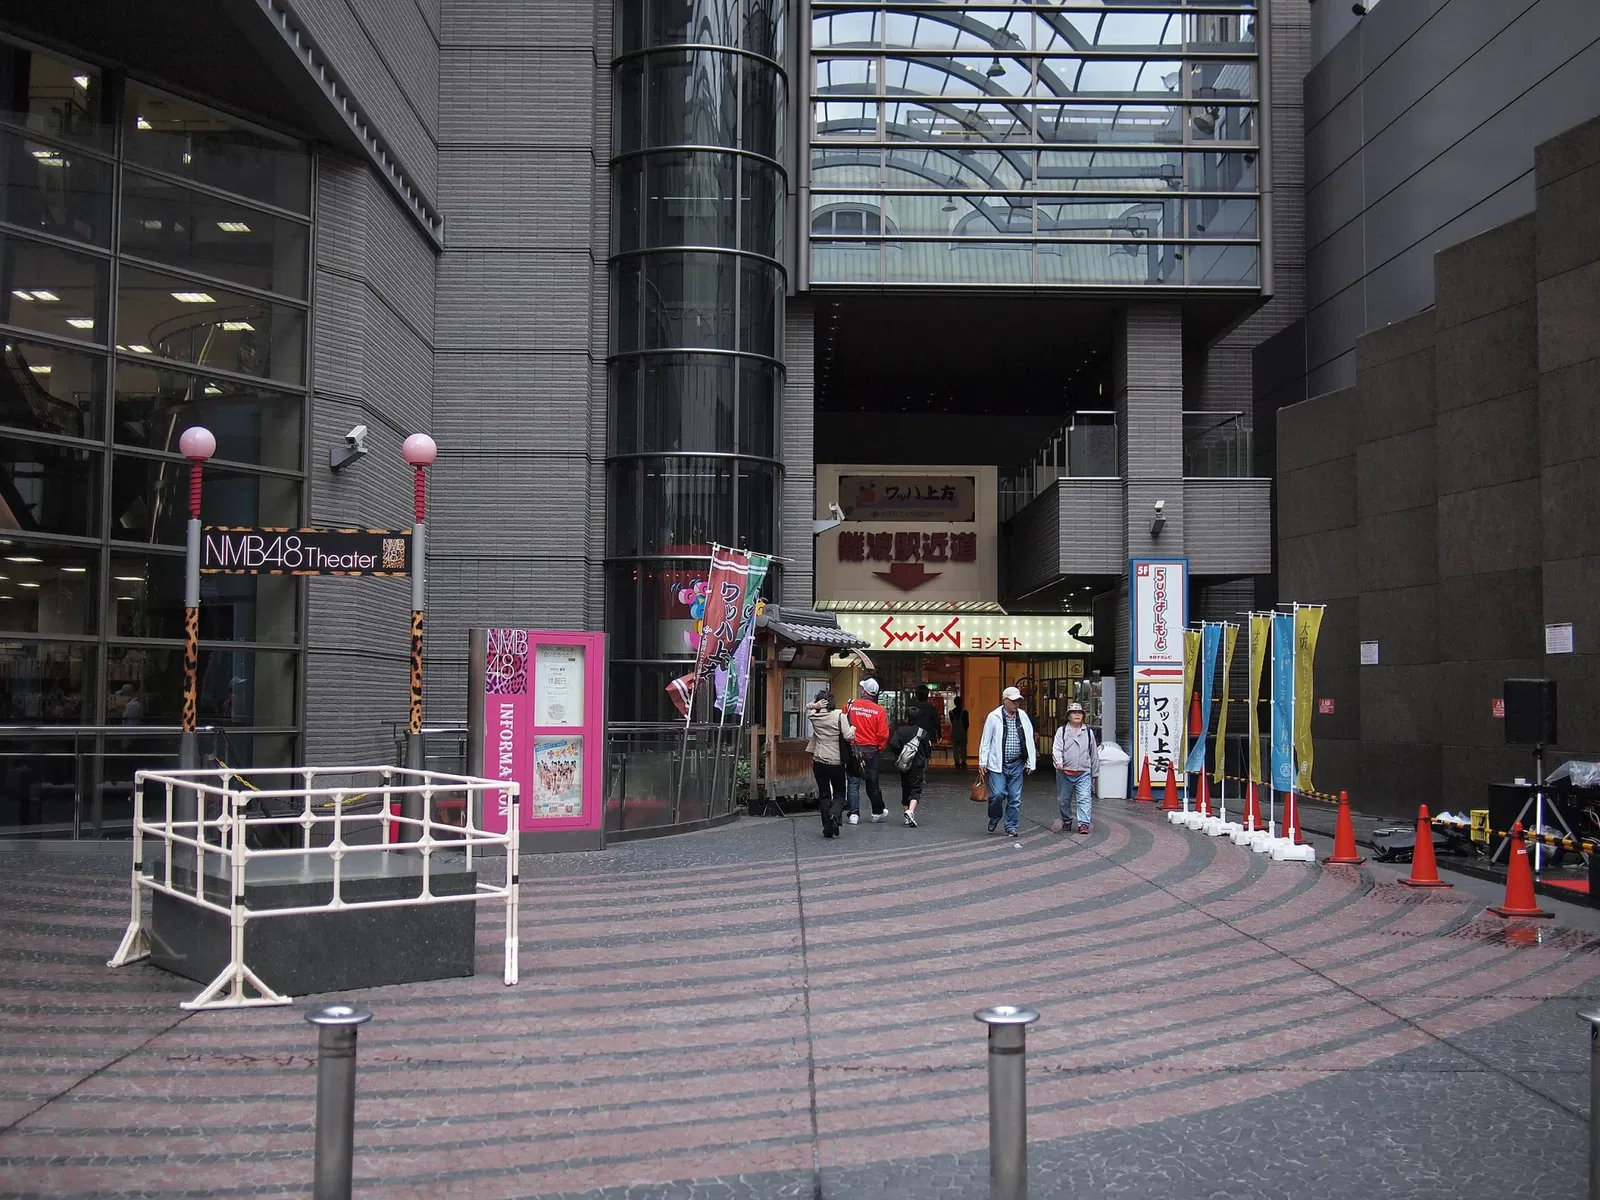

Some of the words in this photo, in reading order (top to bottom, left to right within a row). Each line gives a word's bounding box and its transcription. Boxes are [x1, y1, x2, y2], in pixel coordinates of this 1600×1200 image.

[885, 485, 956, 501] ワッハ上方
[206, 534, 303, 567] NMB48
[304, 547, 378, 568] Theater
[839, 531, 977, 562] 難波駅近道
[1138, 566, 1148, 575] 5F
[486, 629, 528, 655] NMB
[972, 637, 1022, 650] ヨシモト
[486, 654, 514, 680] 48
[1138, 685, 1149, 694] 7F
[1138, 697, 1149, 706] 6F
[1138, 709, 1149, 718] 4F
[1152, 697, 1171, 773] ワッハ上方
[498, 703, 514, 816] INFORMAION
